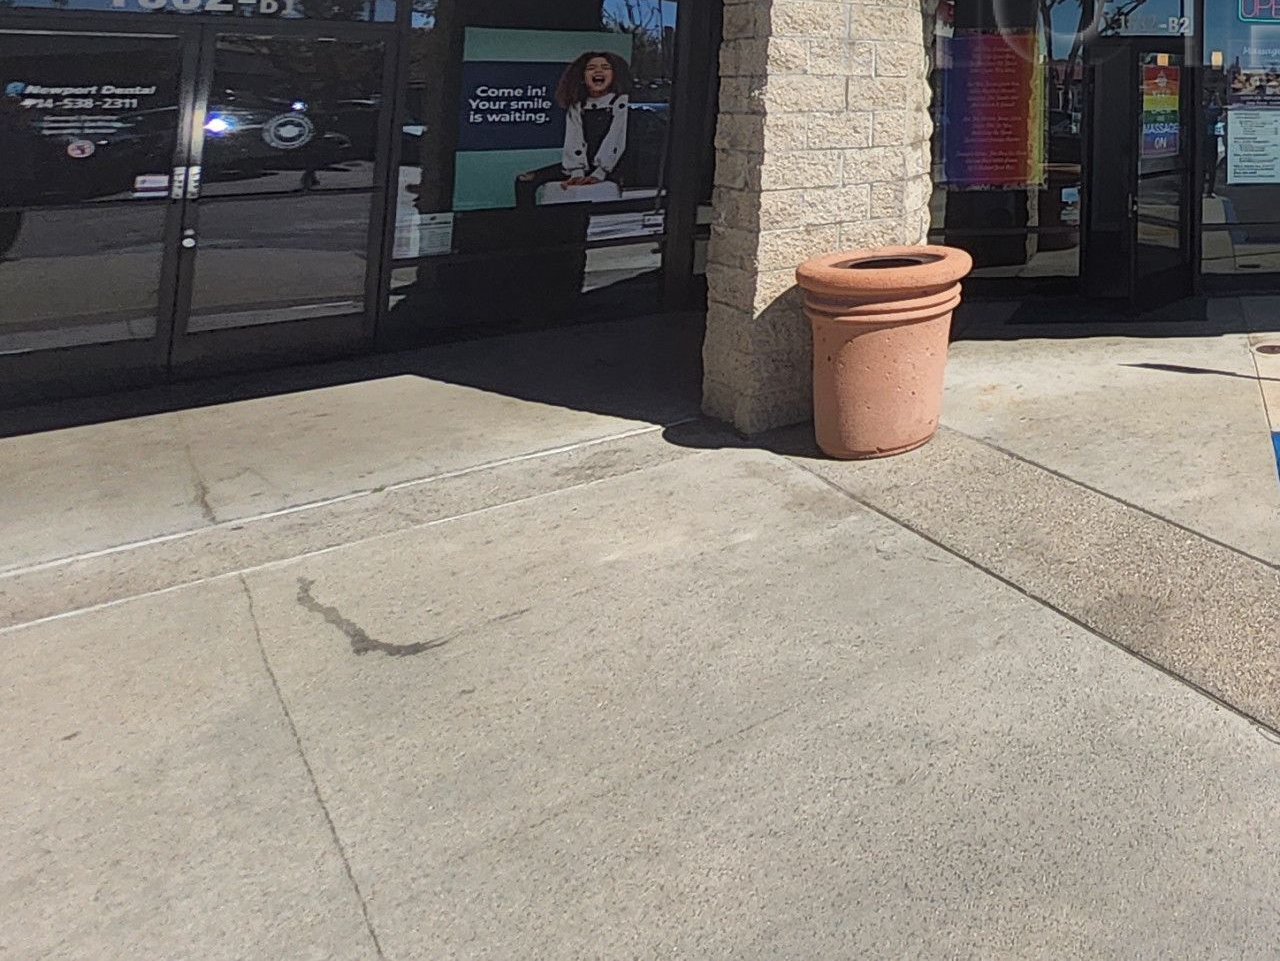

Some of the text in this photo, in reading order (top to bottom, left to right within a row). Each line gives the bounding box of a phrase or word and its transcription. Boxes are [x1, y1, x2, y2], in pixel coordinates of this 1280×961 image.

[24, 84, 157, 96] Newport Dental
[475, 85, 547, 98] Come in!
[469, 98, 552, 110] Your smile
[469, 110, 551, 124] is waiting.
